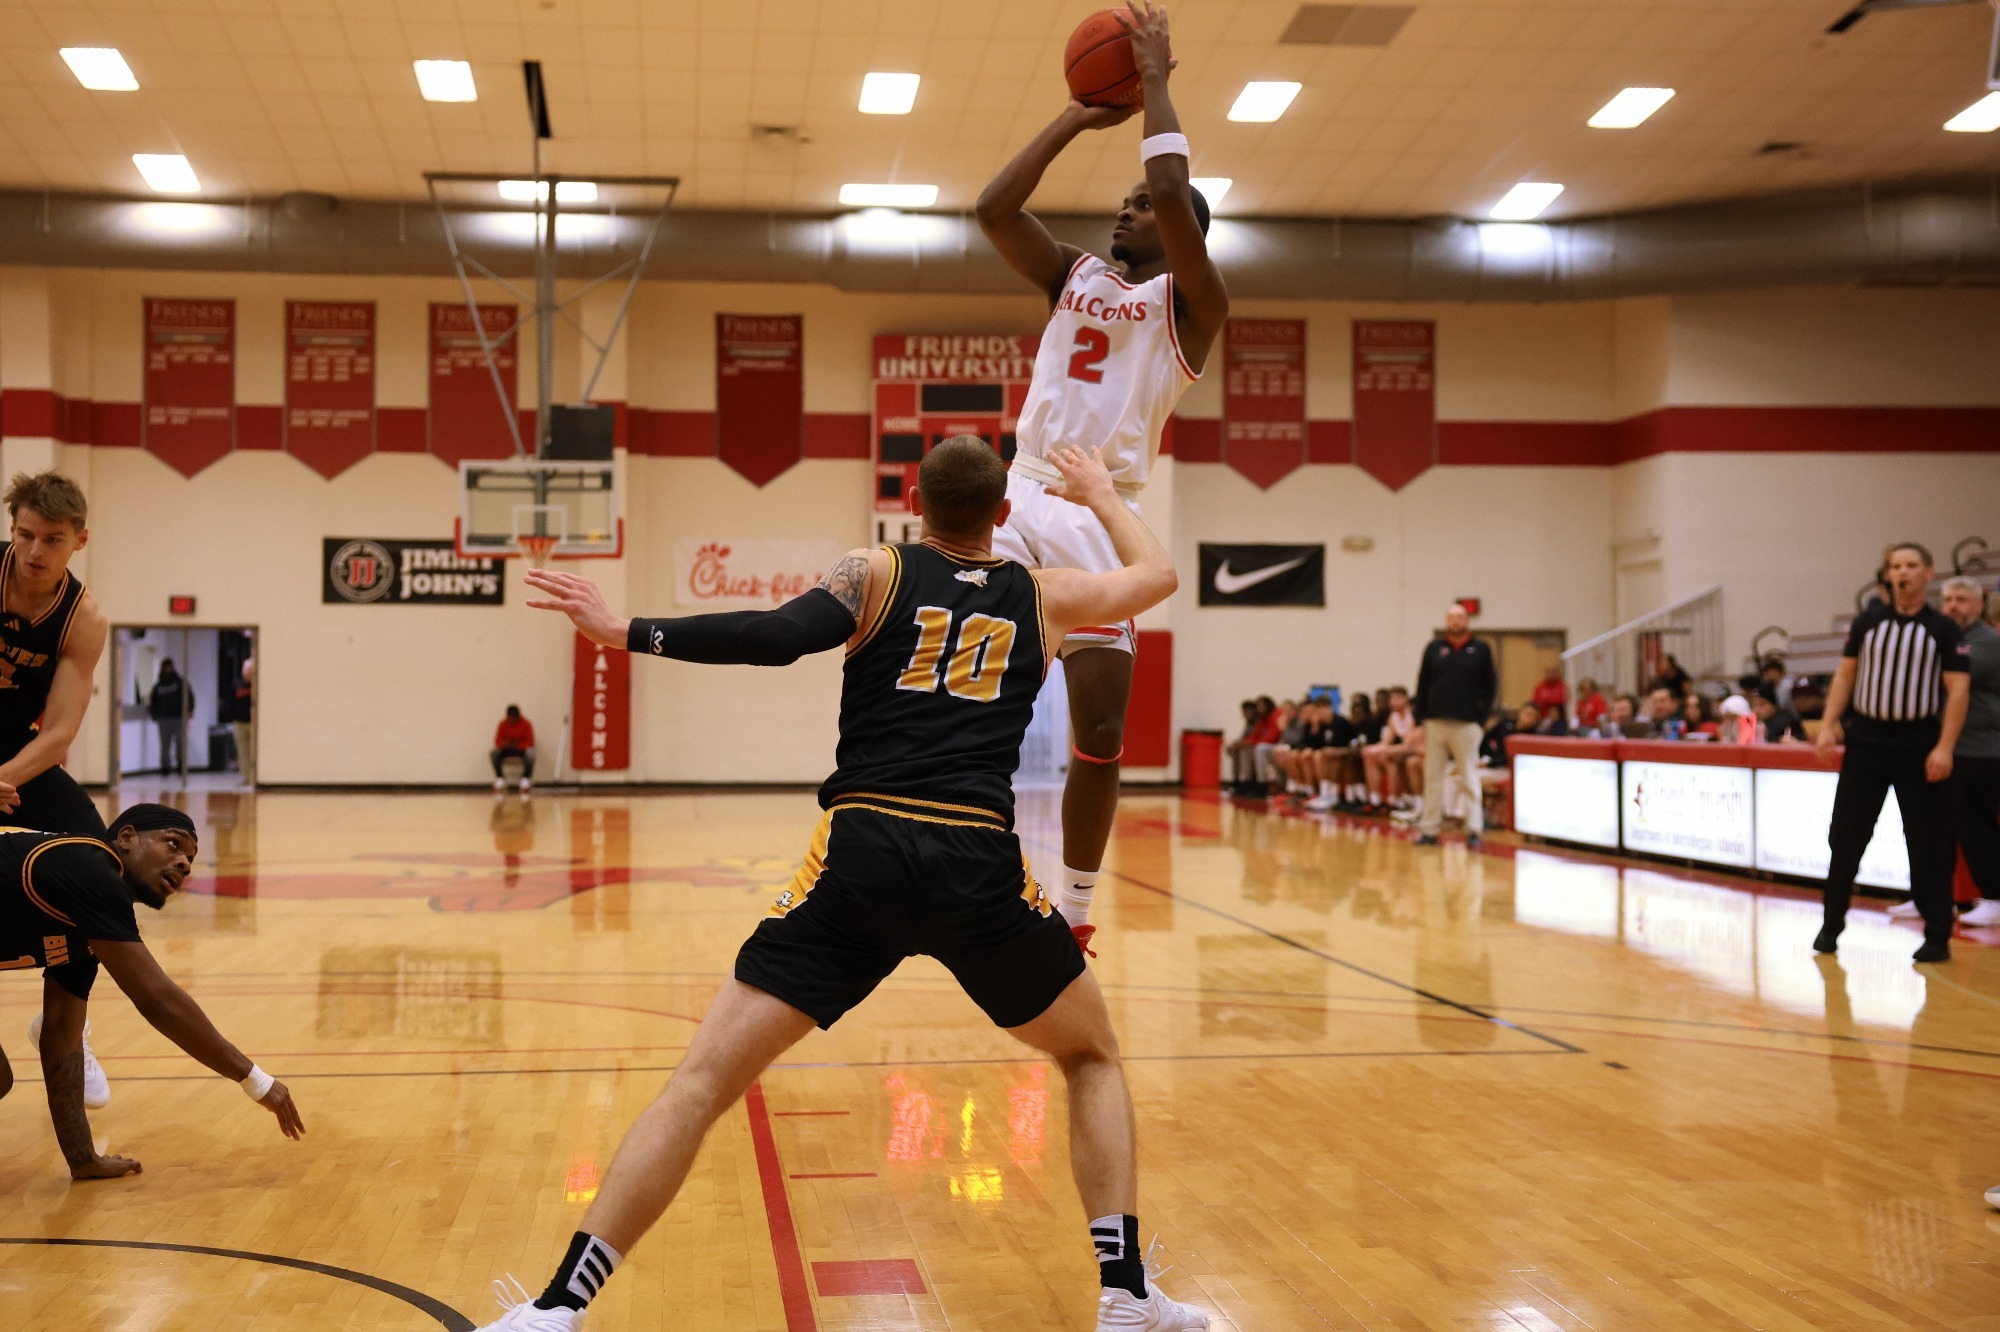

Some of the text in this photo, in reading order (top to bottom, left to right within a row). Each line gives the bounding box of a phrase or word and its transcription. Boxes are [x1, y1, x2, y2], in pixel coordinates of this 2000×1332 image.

[904, 335, 1022, 357] FRIENDS
[1067, 325, 1110, 384] 2
[400, 572, 498, 599] JOHN'S
[895, 606, 1018, 703] 10
